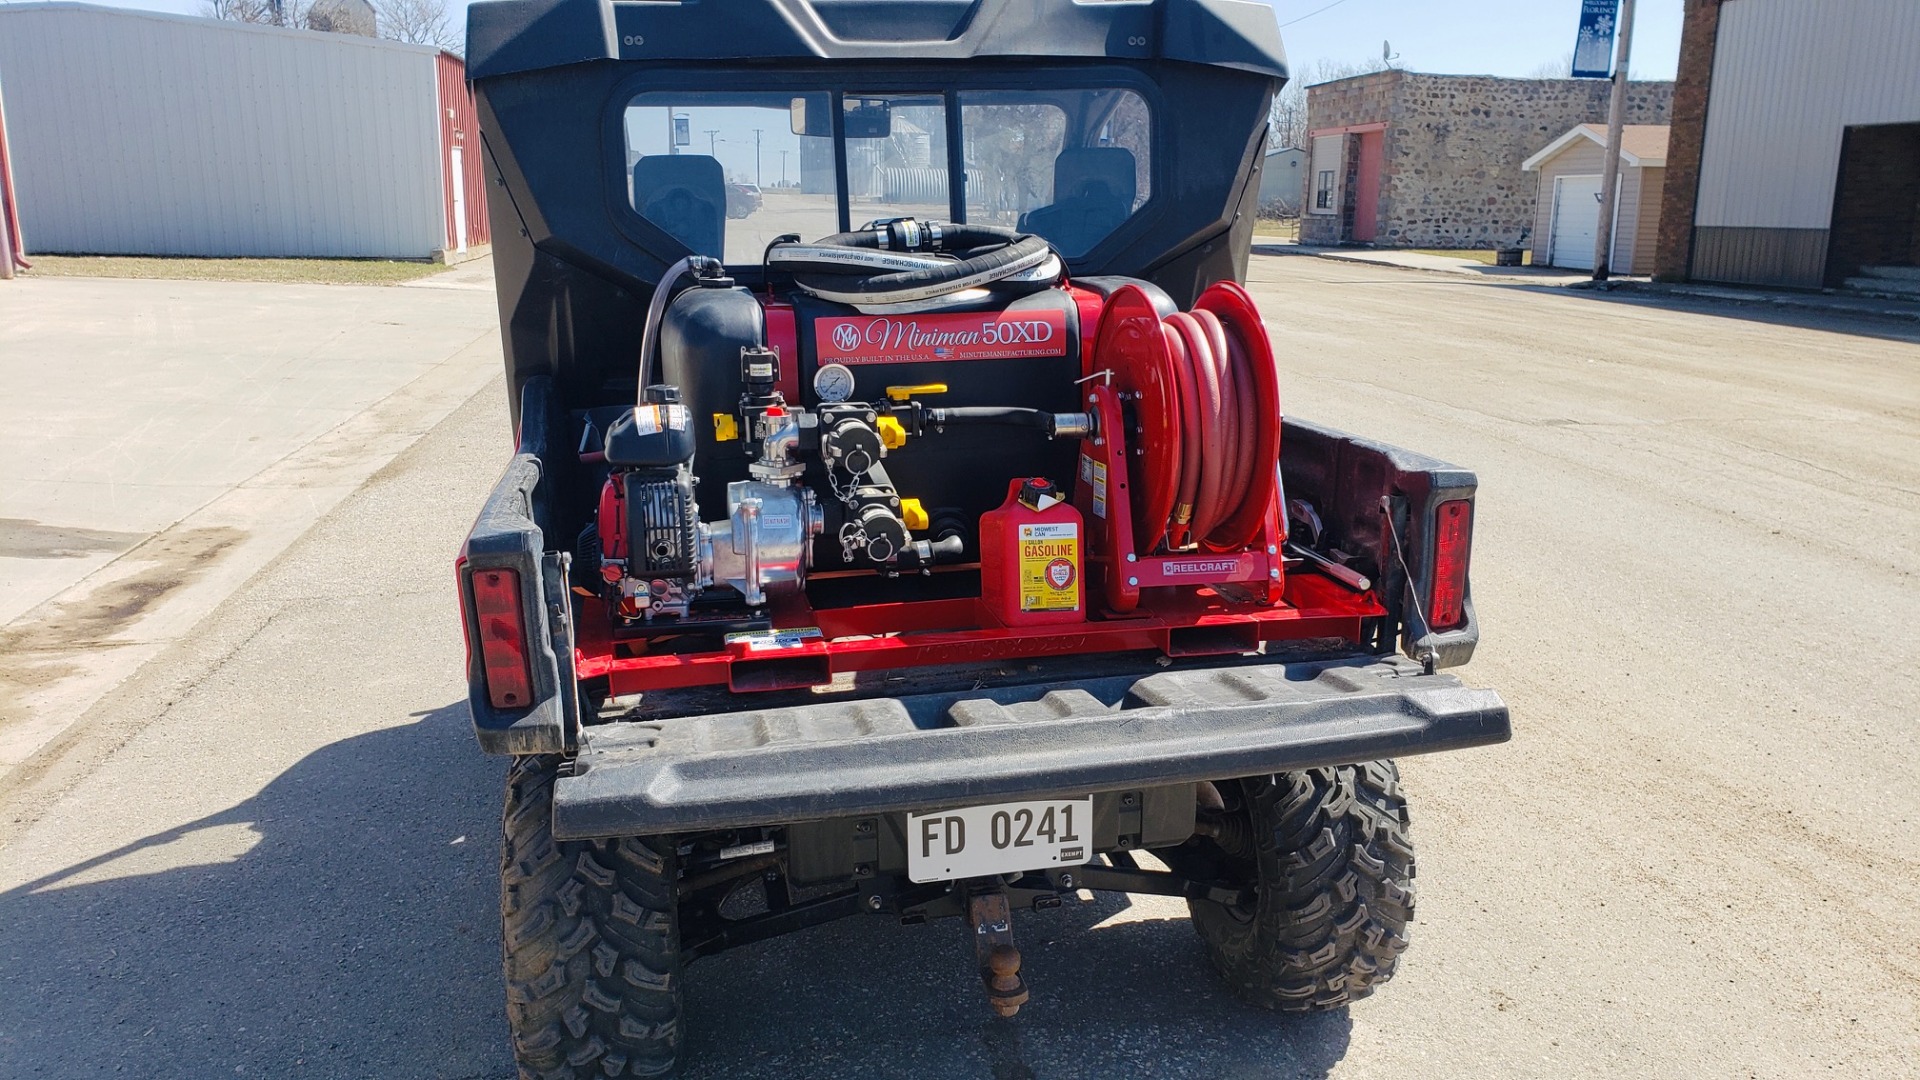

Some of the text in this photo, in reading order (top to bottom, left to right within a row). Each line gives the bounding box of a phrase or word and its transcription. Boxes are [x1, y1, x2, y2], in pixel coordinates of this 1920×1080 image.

[1583, 5, 1615, 14] FLORENCE
[865, 318, 1053, 350] Miniman 50XD
[960, 348, 1061, 358] MINUTEMANUFACTURING.COM
[824, 356, 860, 364] PROUDLY
[861, 355, 884, 363] BUILT
[1024, 544, 1073, 557] GASOLINE
[1173, 562, 1234, 573] REELCRAFT
[922, 804, 1079, 857] FD 0241
[1061, 850, 1083, 858] EXEMPT
